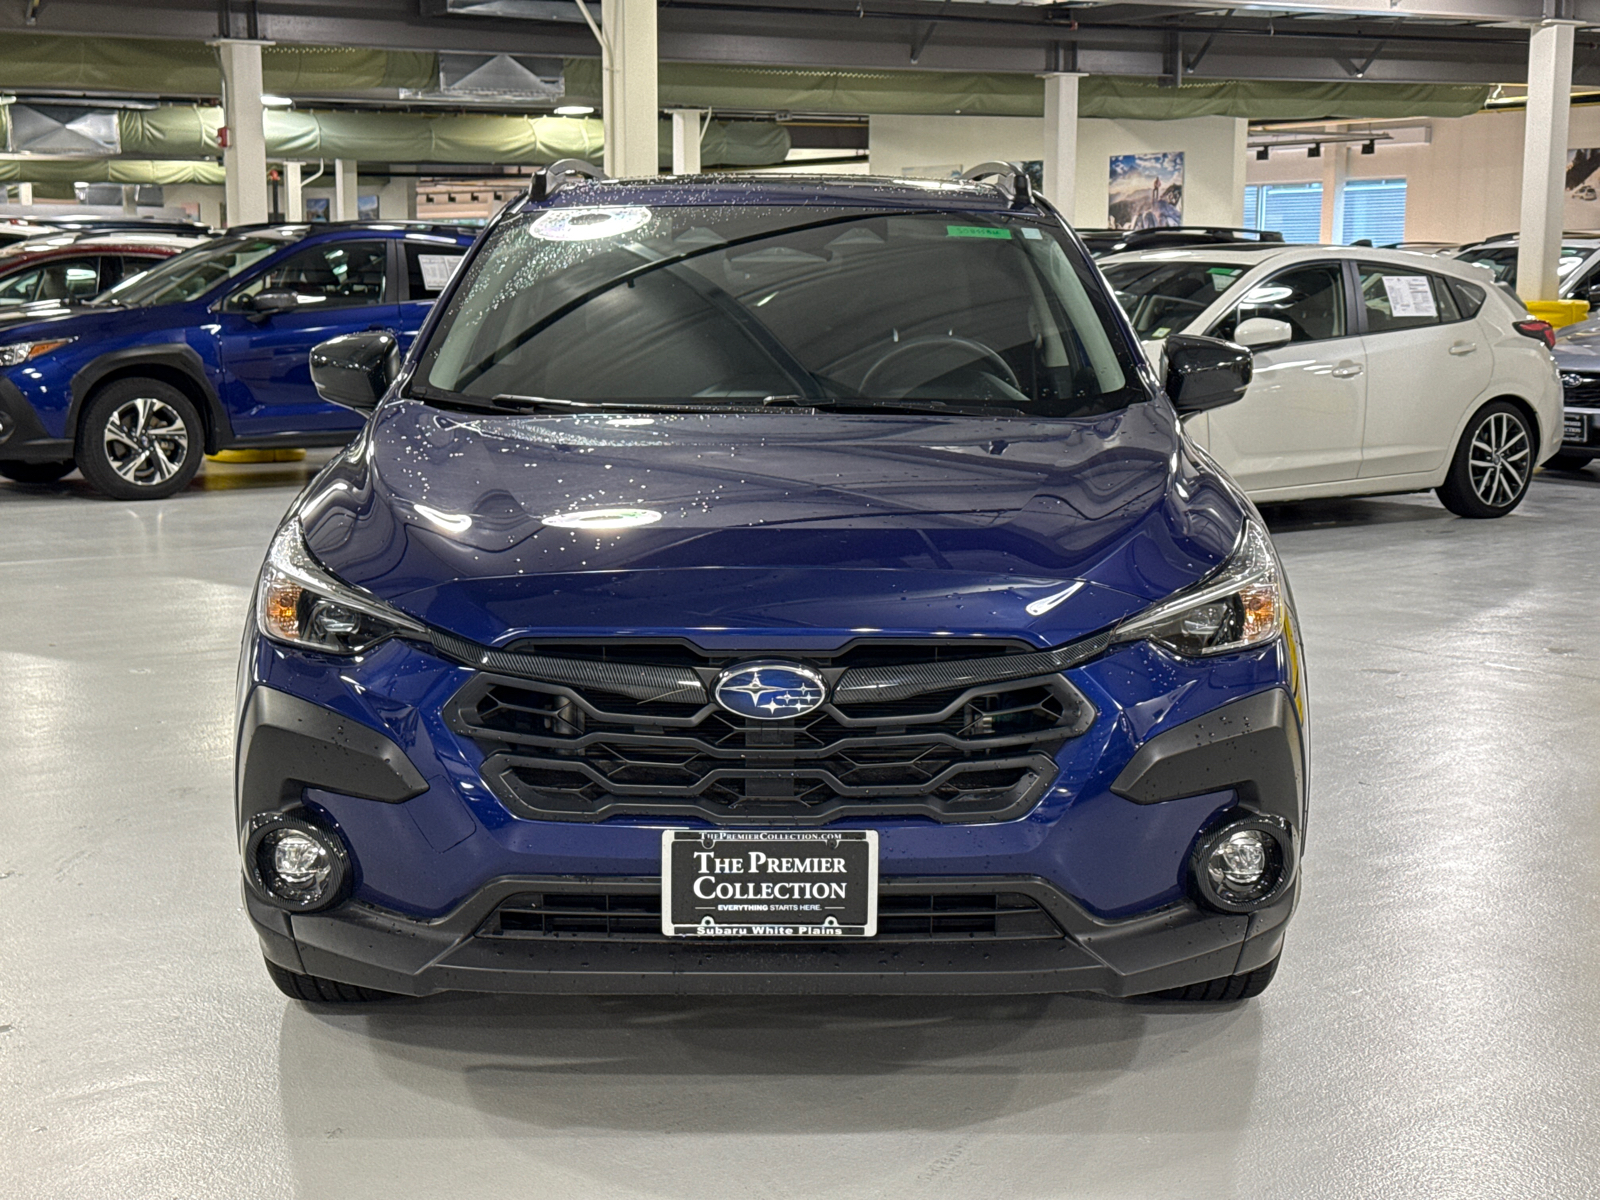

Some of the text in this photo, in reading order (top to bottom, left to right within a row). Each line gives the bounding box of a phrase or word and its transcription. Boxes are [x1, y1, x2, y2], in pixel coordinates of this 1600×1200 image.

[693, 851, 847, 873] THE PREMIER
[693, 876, 847, 900] COLLECTION
[717, 904, 768, 912] EVERYTHING
[769, 904, 798, 912] STARTS
[696, 926, 843, 935] Subaru White Plains
